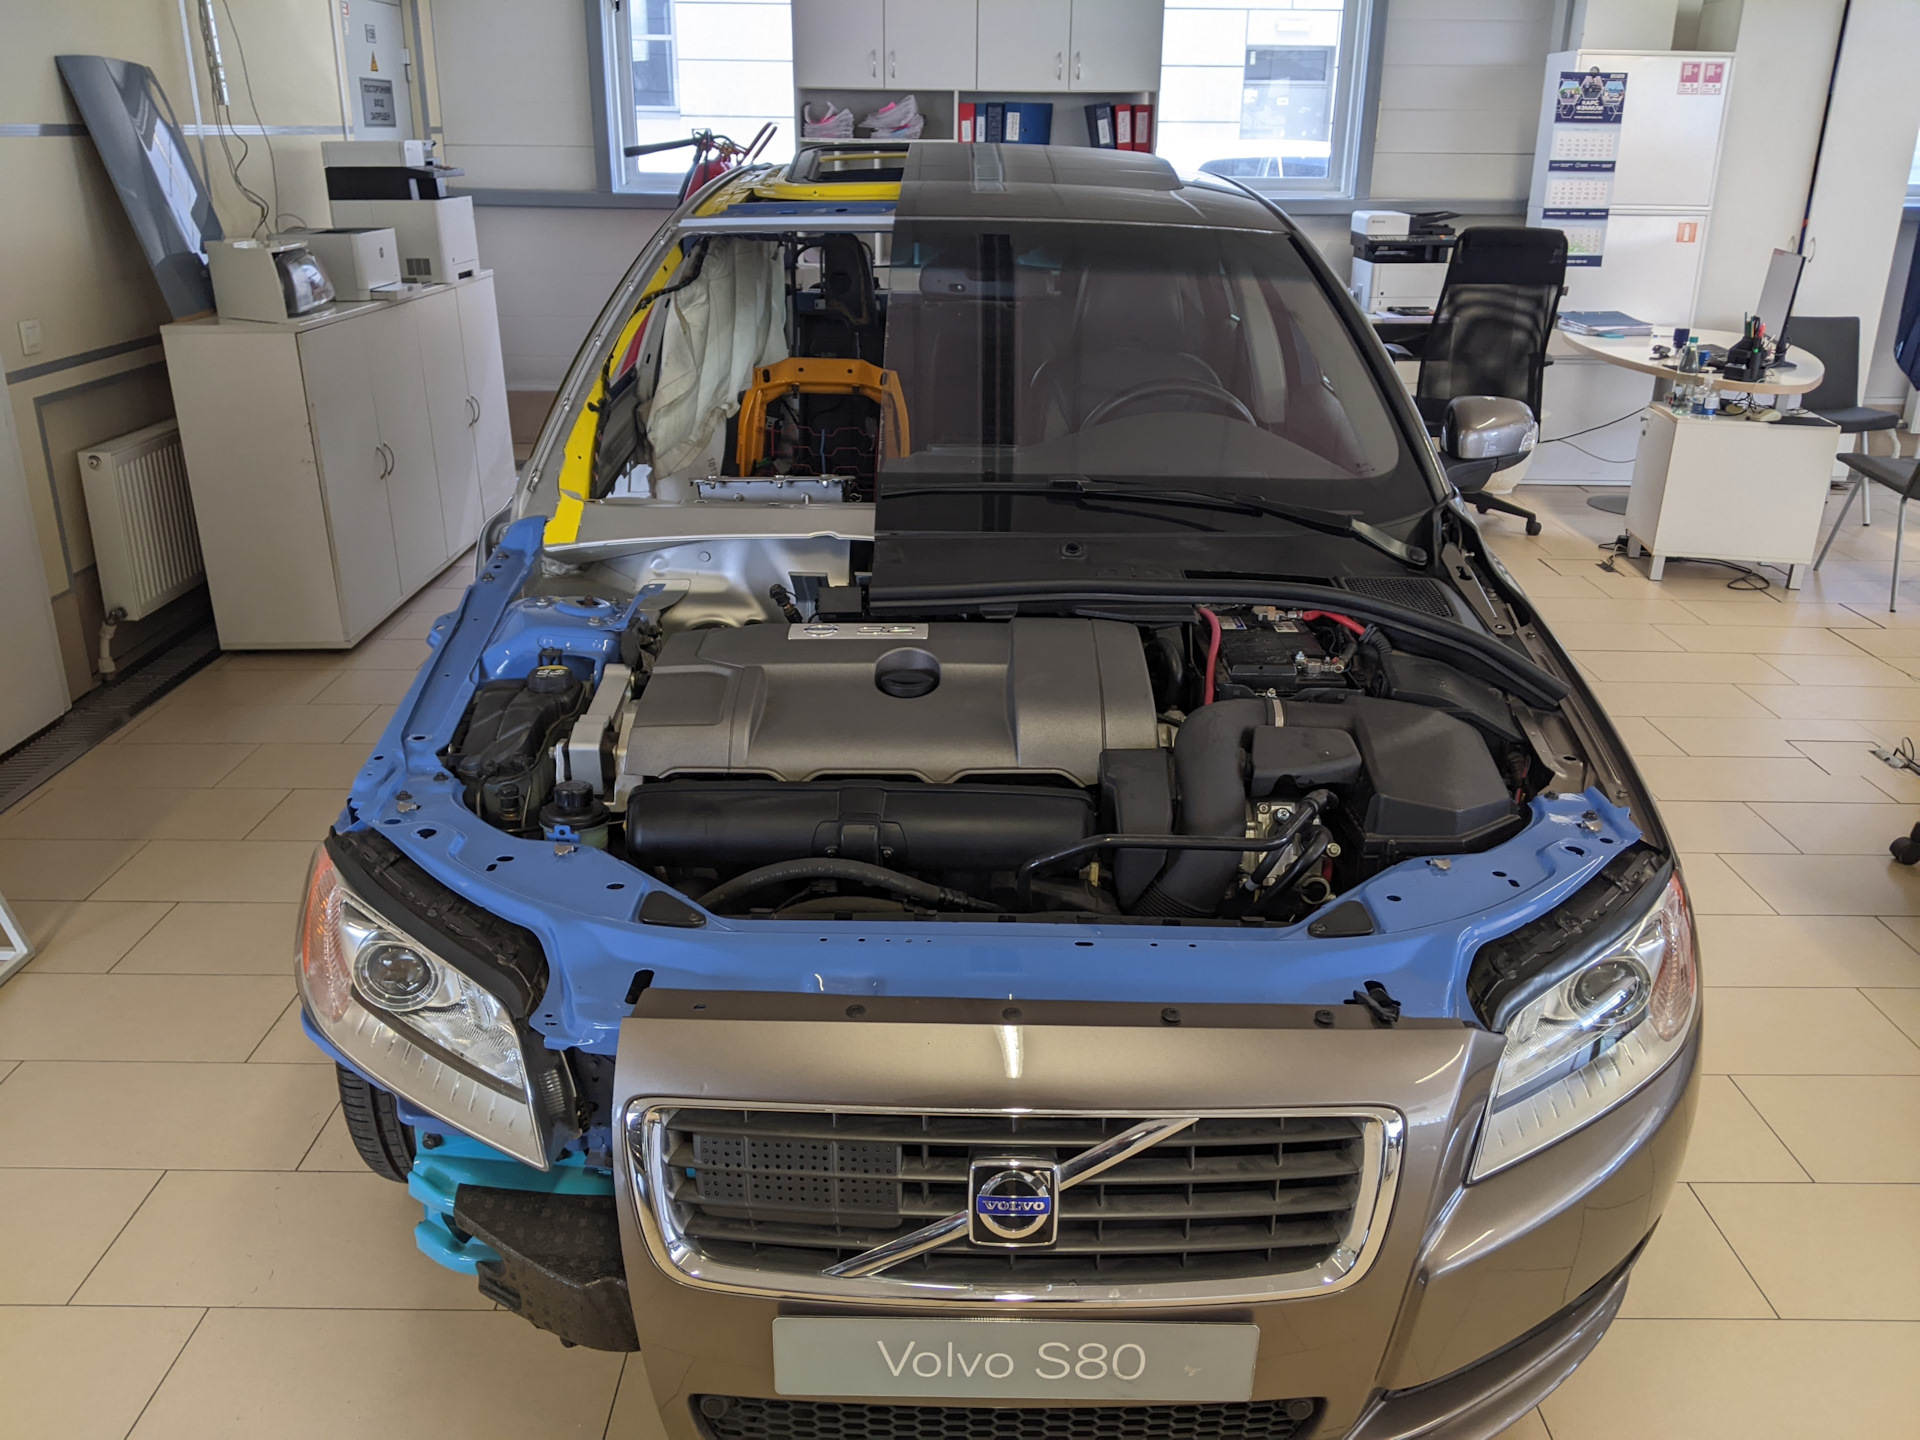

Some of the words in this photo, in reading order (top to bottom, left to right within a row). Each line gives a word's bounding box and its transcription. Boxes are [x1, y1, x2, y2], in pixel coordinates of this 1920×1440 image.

[982, 1200, 1046, 1212] VOLVO
[876, 1340, 1015, 1379] Volvo
[1035, 1341, 1147, 1380] S80
